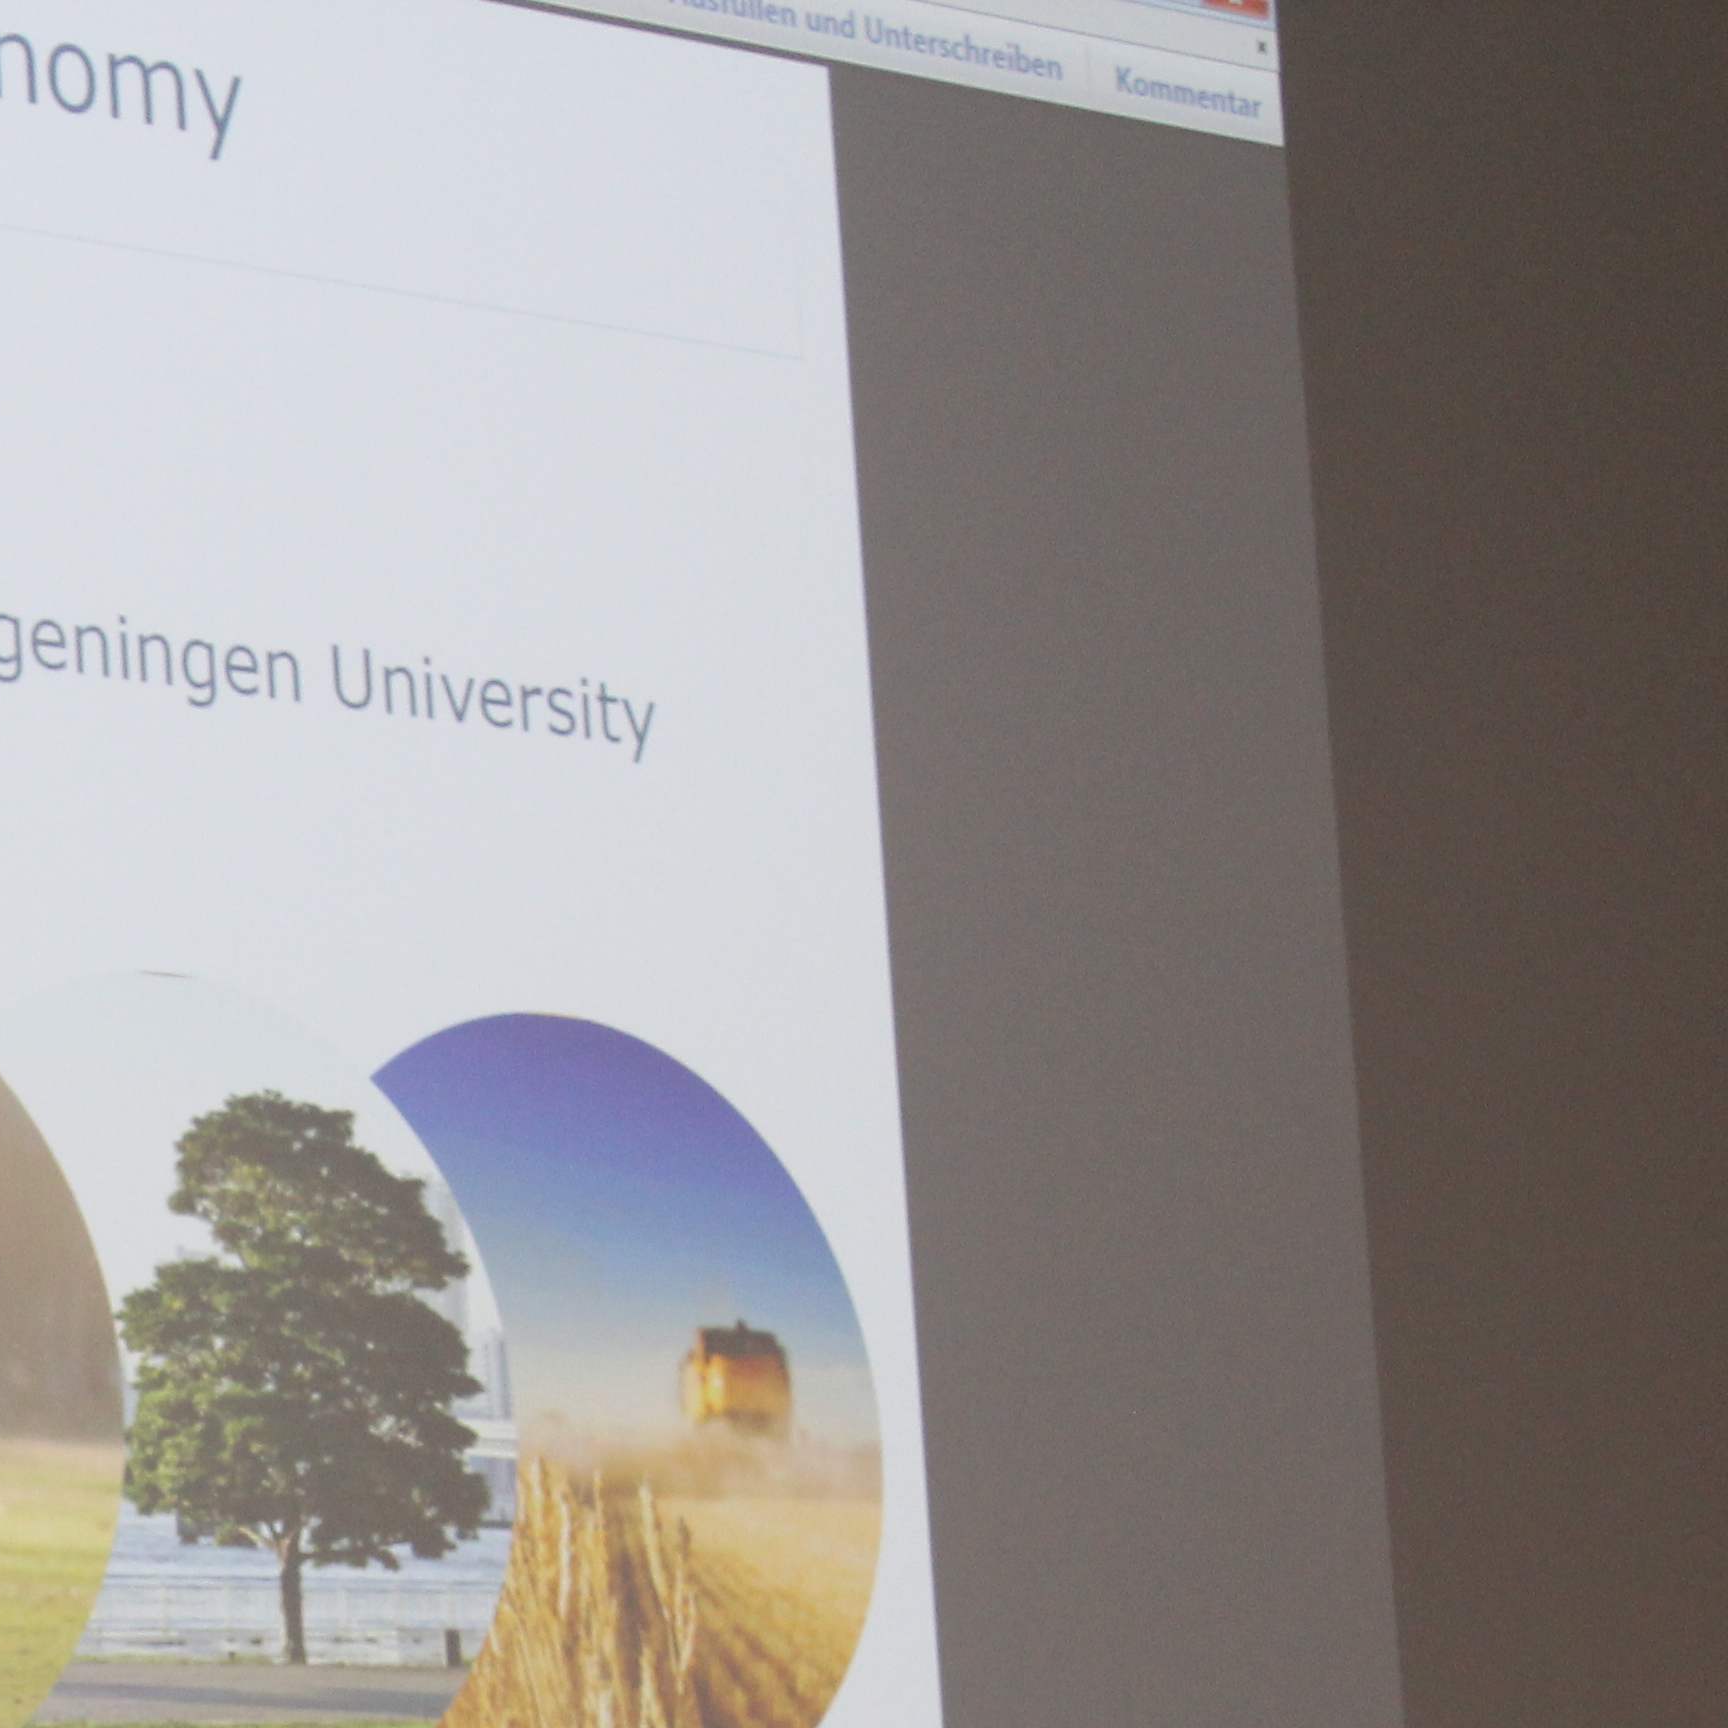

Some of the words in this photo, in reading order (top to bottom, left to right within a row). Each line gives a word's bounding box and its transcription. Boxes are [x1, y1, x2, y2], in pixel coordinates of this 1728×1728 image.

[806, 11, 856, 39] und
[864, 16, 1064, 81] Unterschreiben
[1115, 64, 1262, 118] Kommentar
[332, 644, 656, 764] University
